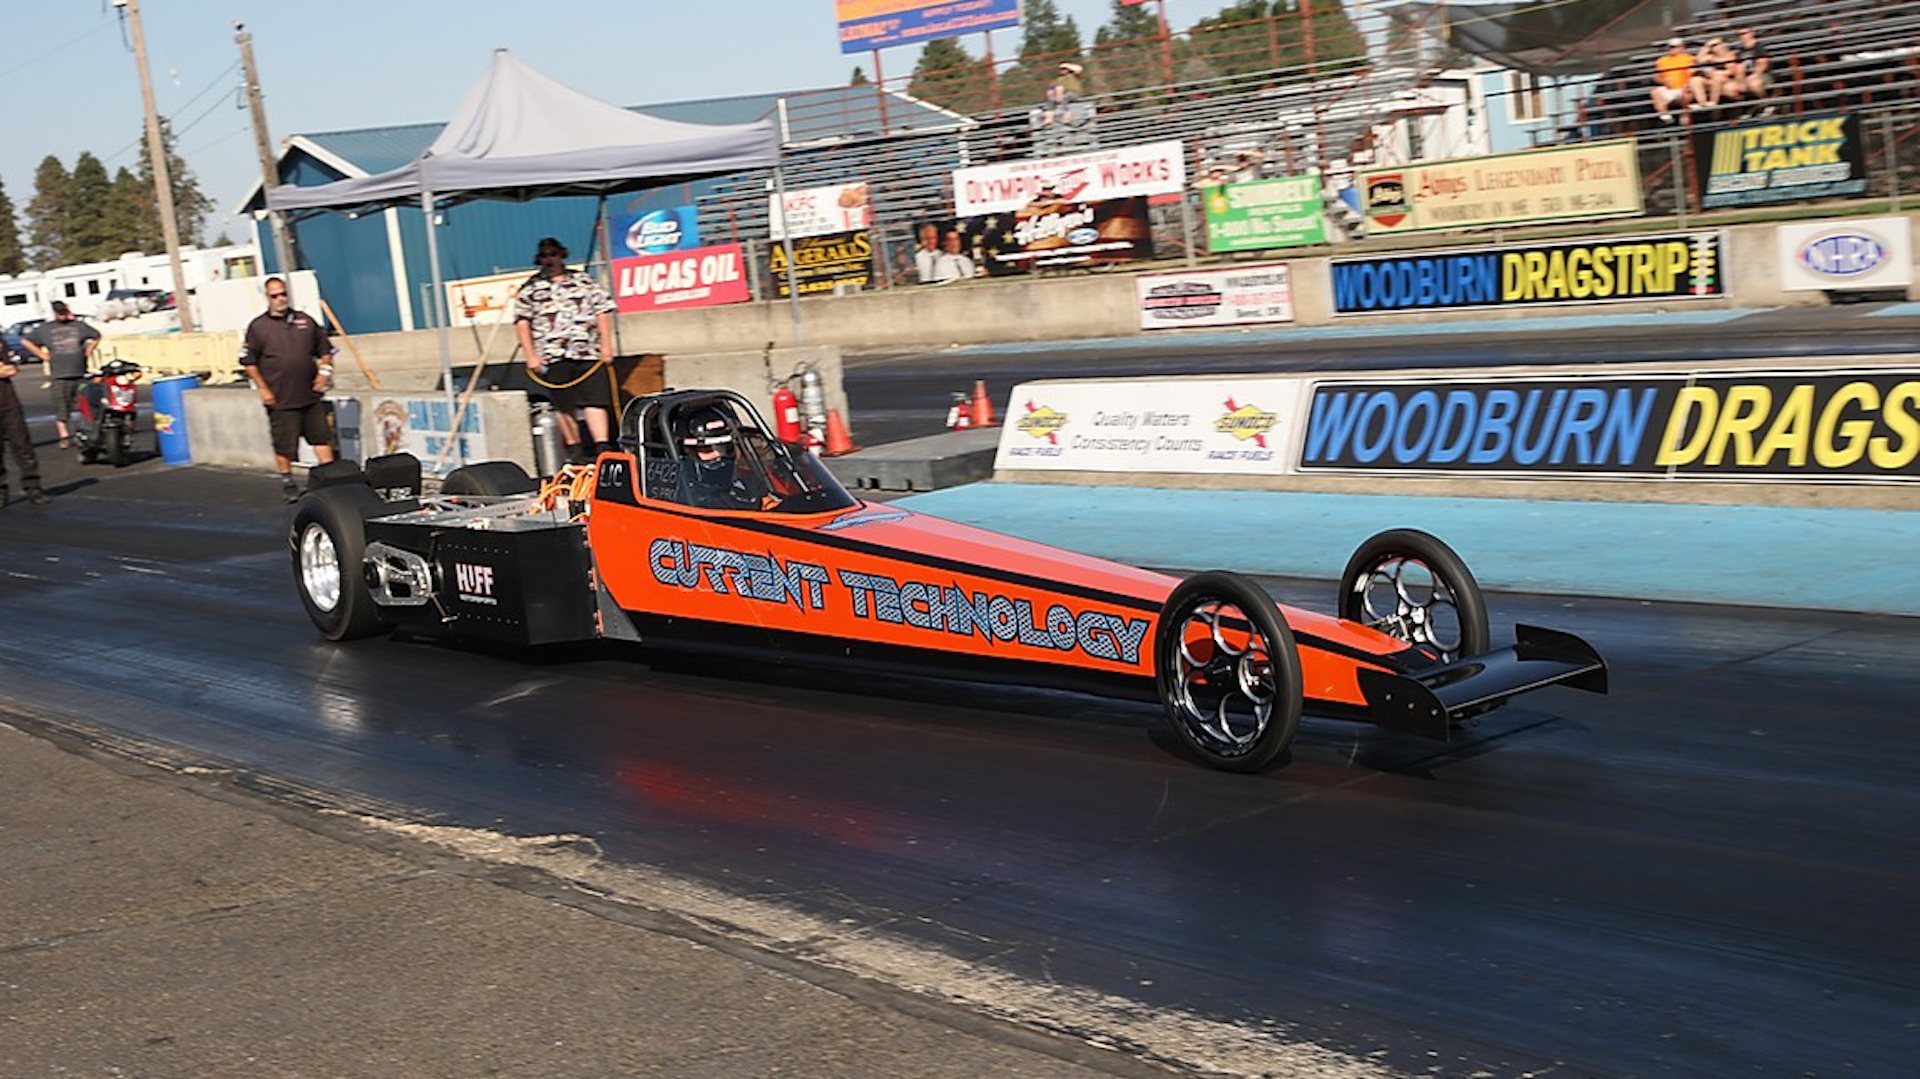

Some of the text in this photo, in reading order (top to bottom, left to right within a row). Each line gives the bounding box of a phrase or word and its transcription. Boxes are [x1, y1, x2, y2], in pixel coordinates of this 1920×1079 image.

[1742, 116, 1846, 149] TRICK
[1098, 158, 1171, 189] WORKS
[1744, 143, 1843, 171] TANK
[1477, 165, 1565, 191] LEGENDARY
[1575, 157, 1626, 181] PIZZA
[1804, 234, 1883, 274] NHRA
[619, 257, 697, 297] LUCAS
[700, 252, 739, 286] OIL
[1333, 241, 1688, 310] WOODBURN DRAGSTRIP
[1092, 410, 1138, 431] Quality
[1218, 416, 1277, 429] SUNOCO
[1304, 381, 1920, 469] WOODBURN DRAGS
[1071, 434, 1203, 455] Consistency Counts
[648, 537, 1151, 666] CURRENT TECHNOLOGY
